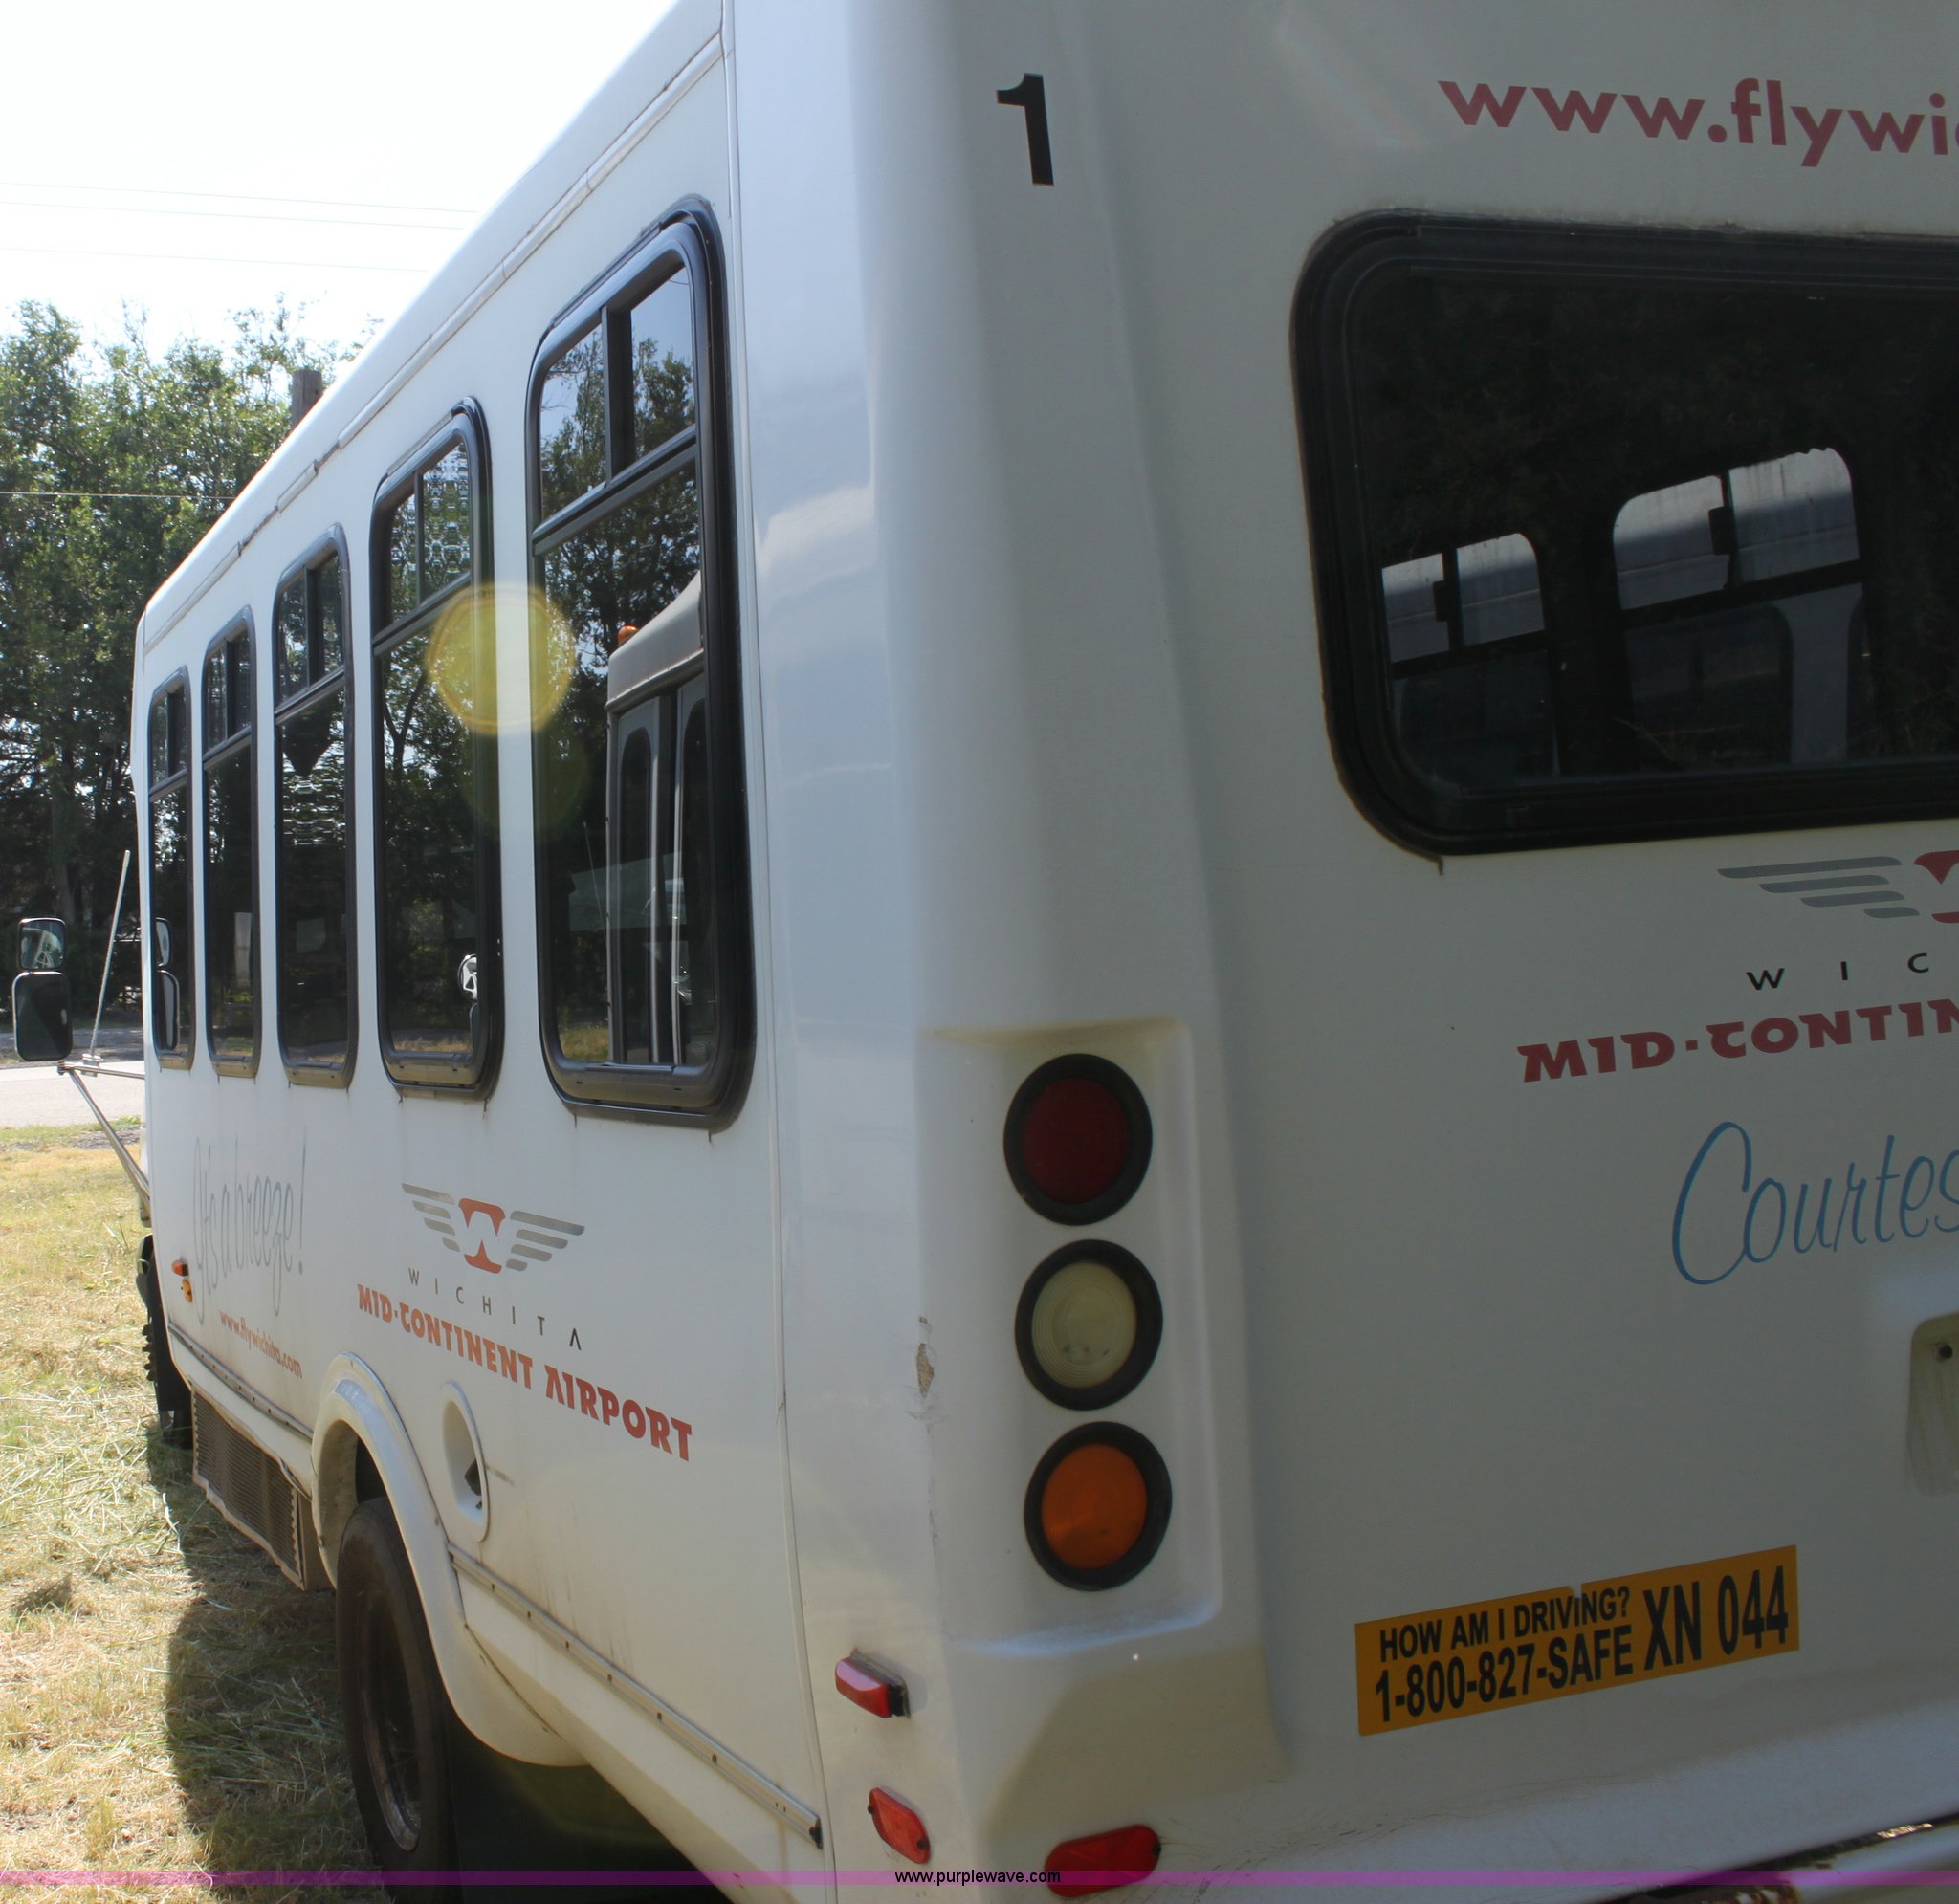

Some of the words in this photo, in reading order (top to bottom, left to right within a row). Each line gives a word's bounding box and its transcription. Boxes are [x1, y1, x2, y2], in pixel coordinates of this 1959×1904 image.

[996, 73, 1054, 186] 1
[1438, 77, 1959, 167] www.flywi
[408, 1267, 582, 1351] WICHITA
[544, 1364, 693, 1462] AIRPORT
[1379, 1620, 1442, 1662] HOW
[1450, 1611, 1489, 1650] AM
[1498, 1609, 1506, 1641] I
[1514, 1585, 1631, 1638] DRIVING?
[1643, 1581, 1702, 1671] XN
[1718, 1565, 1789, 1655] 044
[1376, 1625, 1634, 1722] 1-800-827-SAFE
